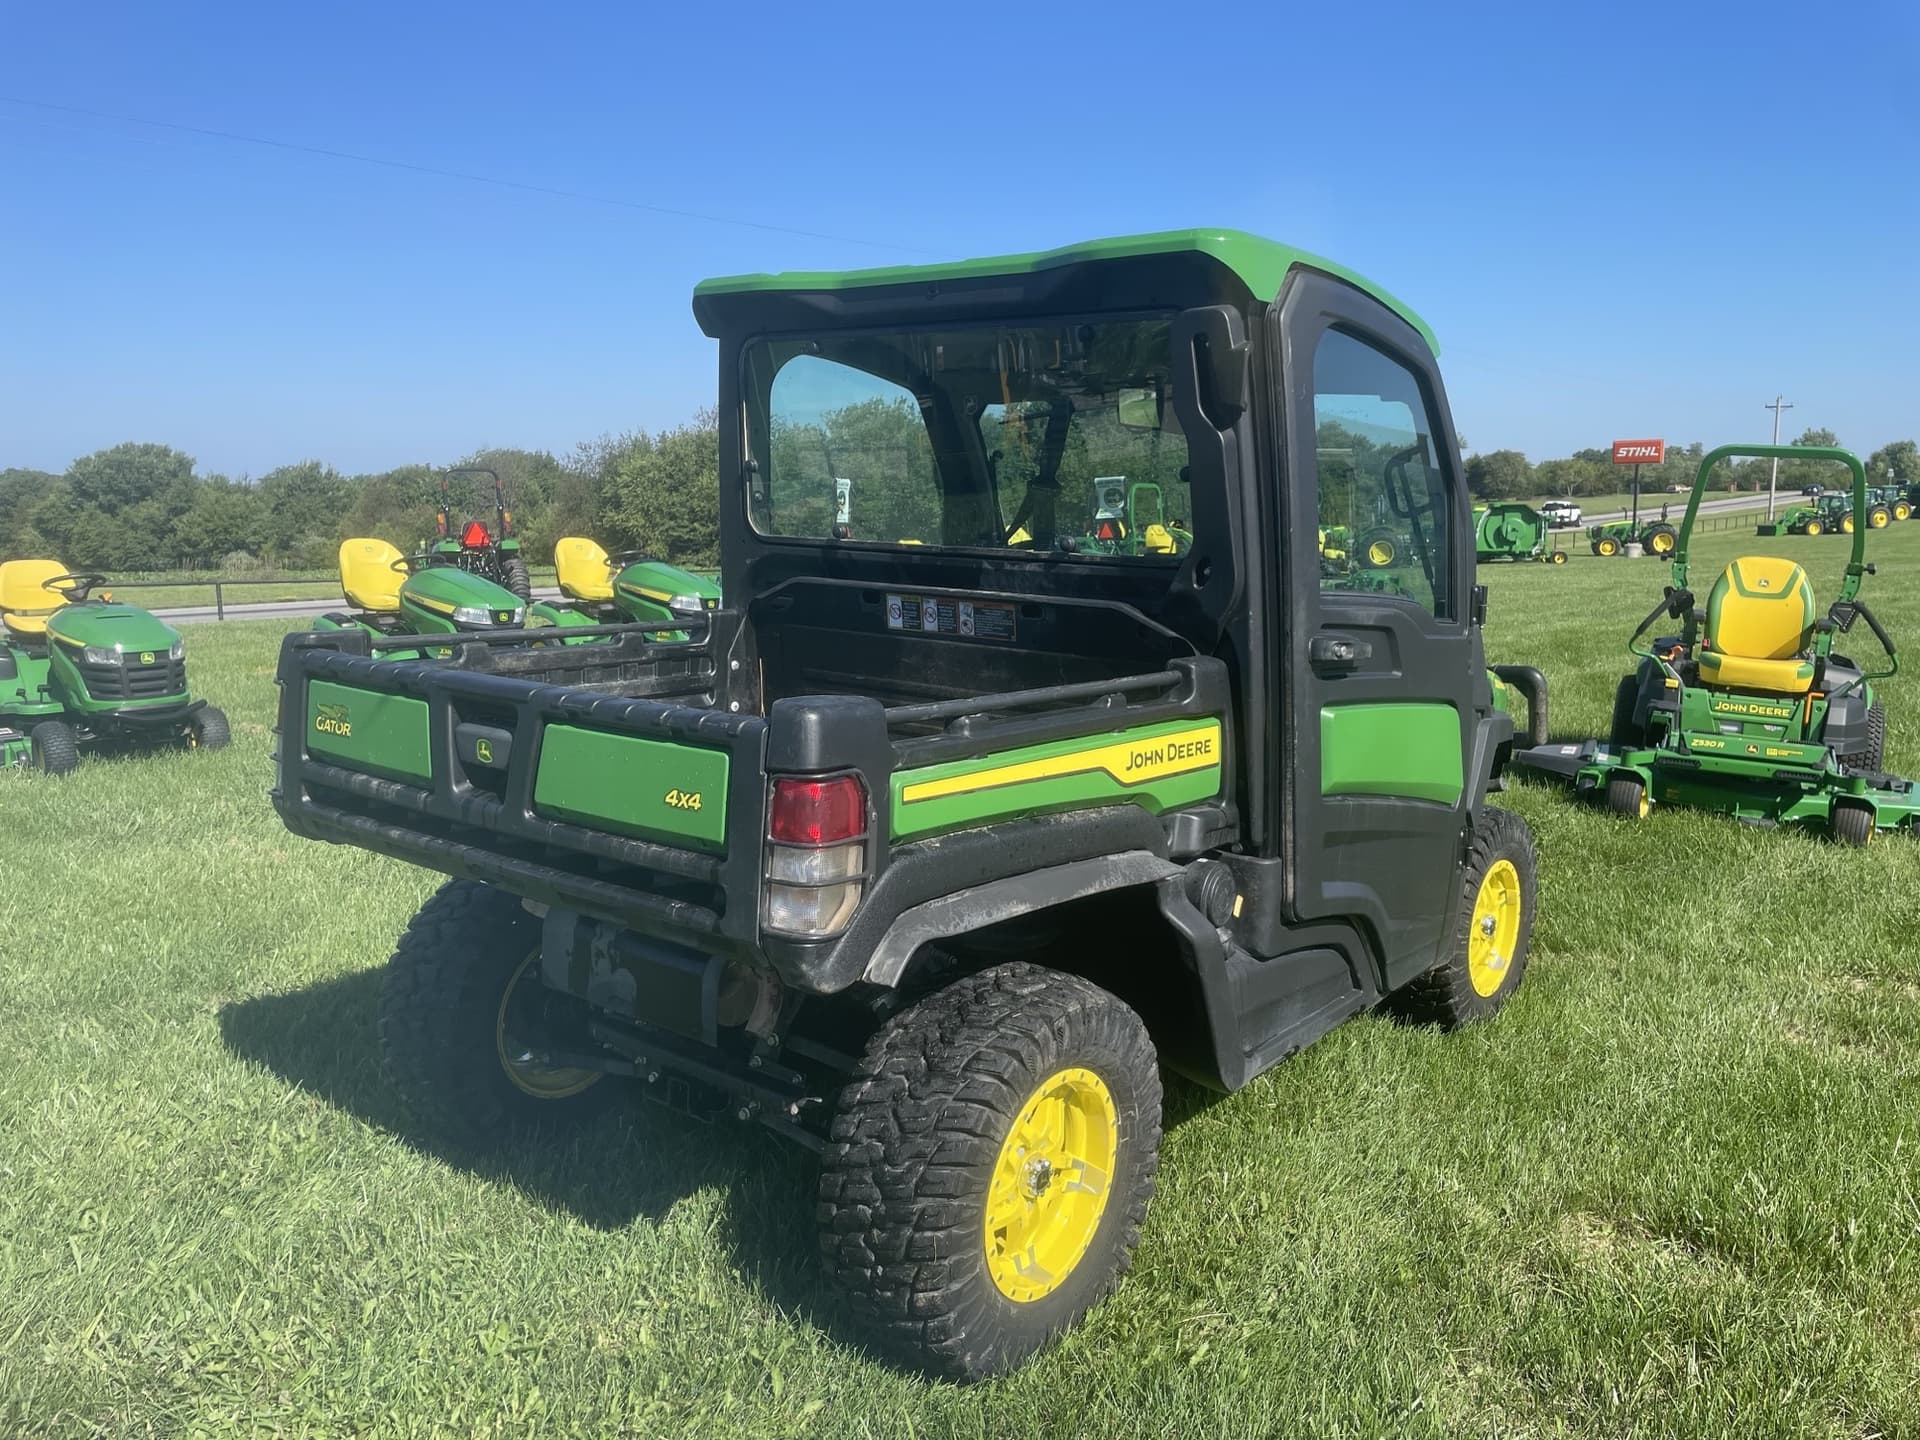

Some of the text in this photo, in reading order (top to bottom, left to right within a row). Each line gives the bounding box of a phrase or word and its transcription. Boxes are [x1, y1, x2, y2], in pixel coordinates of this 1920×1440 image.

[1616, 446, 1659, 457] STIHL
[1714, 701, 1790, 717] JOHN DEERE
[316, 716, 352, 736] GATOR
[1126, 739, 1211, 771] JOHN DEERE
